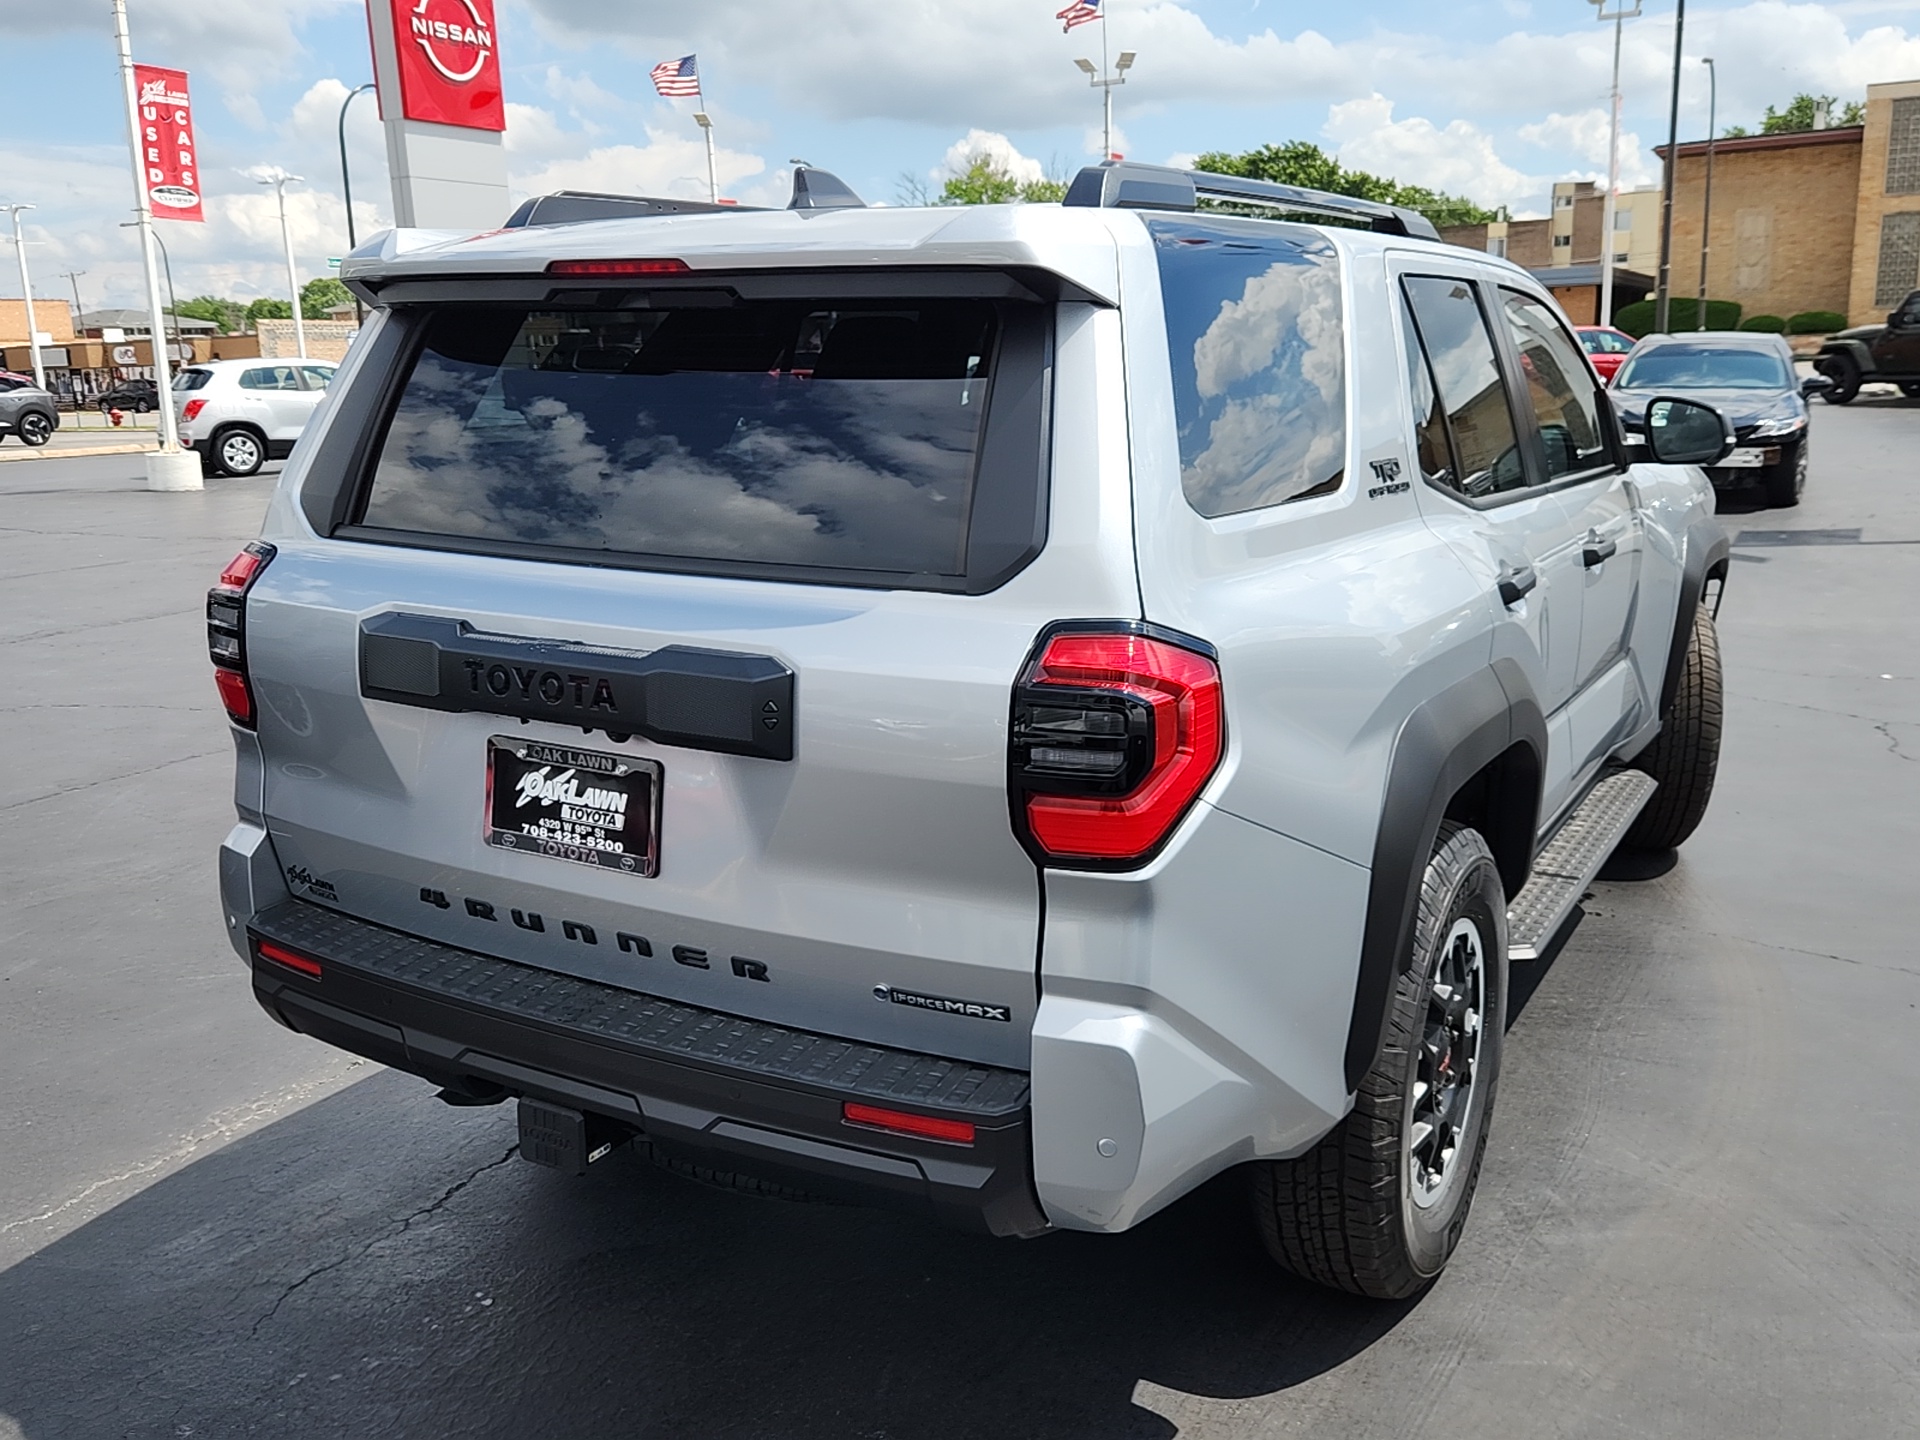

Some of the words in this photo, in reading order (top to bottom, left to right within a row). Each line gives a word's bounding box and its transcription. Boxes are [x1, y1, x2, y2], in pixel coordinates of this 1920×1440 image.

[411, 16, 492, 47] NISSAN
[142, 105, 164, 183] USED
[174, 109, 194, 186] CARS
[462, 658, 619, 714] TOYOTA
[531, 747, 564, 763] OAK
[567, 750, 613, 771] LAWN
[538, 817, 561, 831] 4320
[562, 821, 572, 832] W
[593, 827, 606, 839] St
[568, 805, 617, 826] TOYOTA
[521, 823, 624, 853] 708-423-5200
[536, 838, 600, 865] TOYOTA
